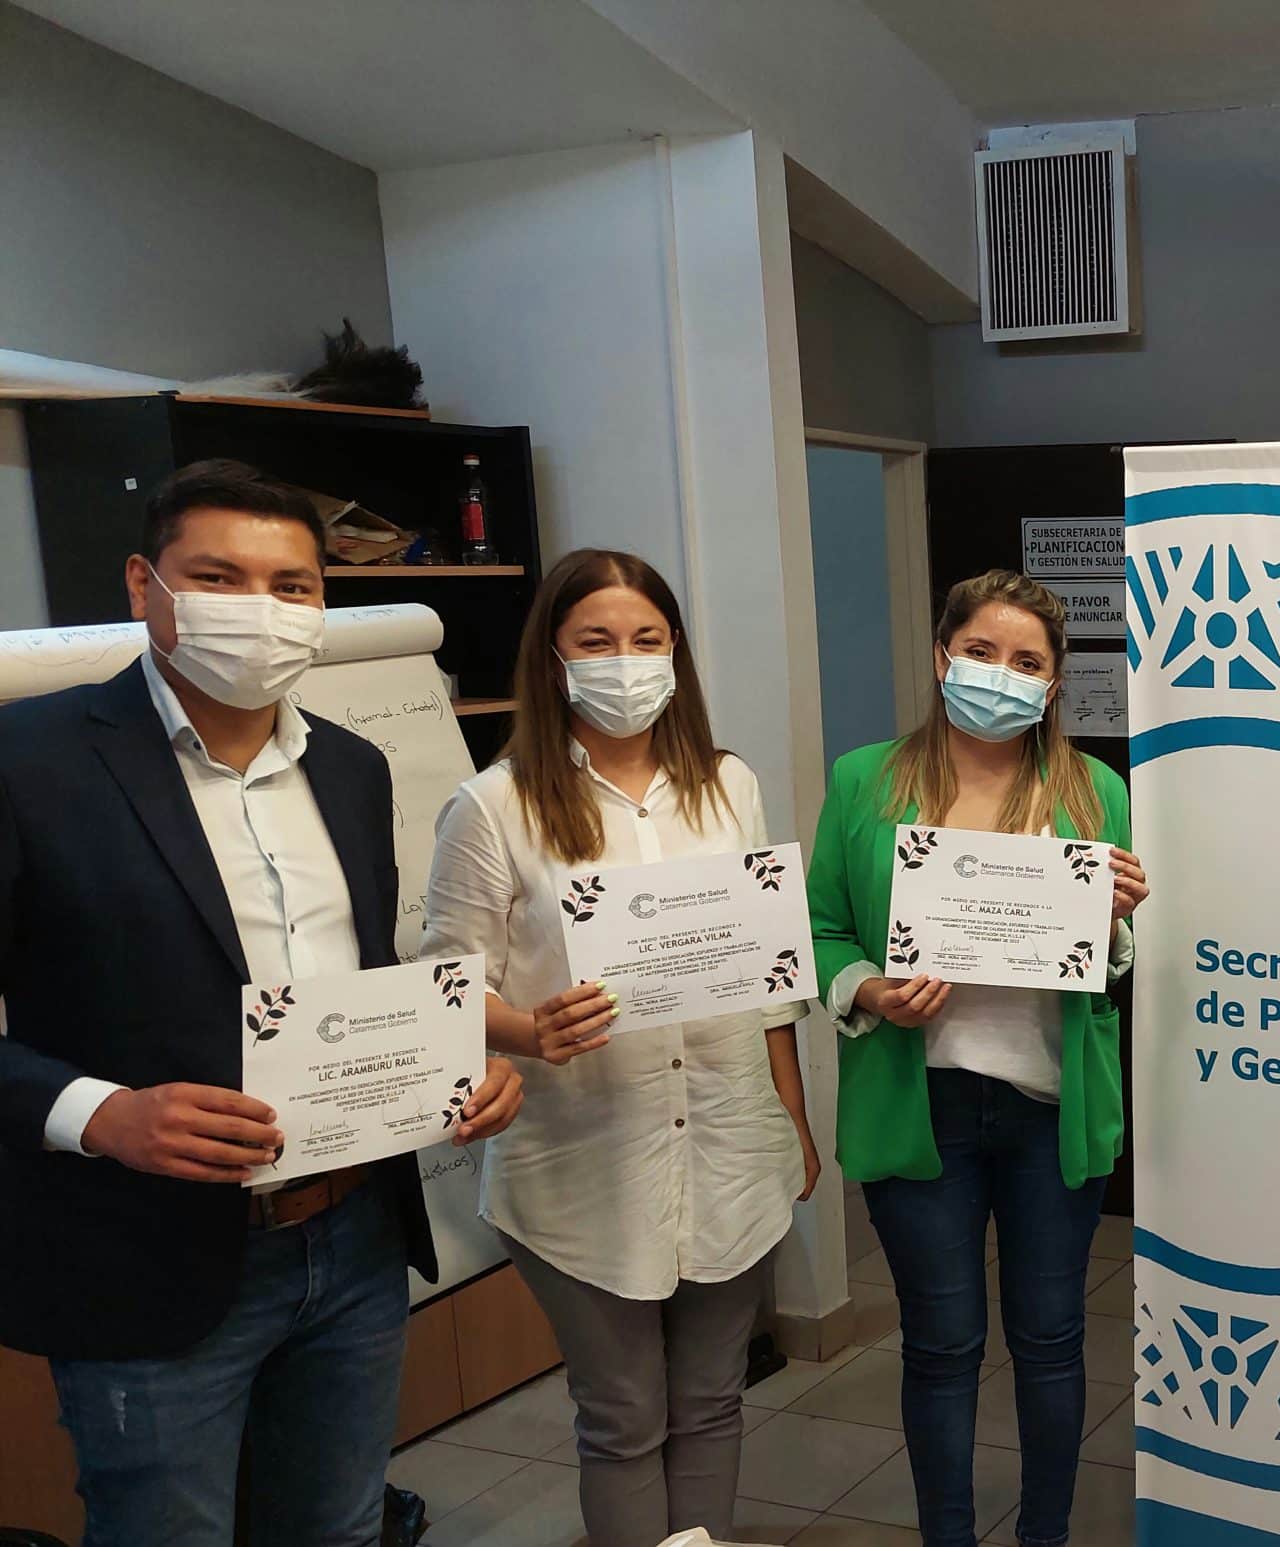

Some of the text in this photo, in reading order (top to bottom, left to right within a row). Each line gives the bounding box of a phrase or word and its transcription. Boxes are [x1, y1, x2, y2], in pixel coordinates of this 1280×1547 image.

[1031, 527, 1121, 538] SUBSECRETARIA DE
[1030, 540, 1124, 553] PLANIFICACION
[1029, 557, 1036, 567] Y
[1081, 556, 1093, 567] EN
[1095, 556, 1125, 567] SALUD
[1072, 596, 1111, 607] FAVOR
[1073, 611, 1123, 622] ANUNCIAR
[981, 862, 1014, 870] Ministerio
[659, 893, 695, 903] Ministerio
[707, 888, 727, 896] Salud
[960, 904, 1031, 916] LIC. MAZA CARLA
[638, 930, 732, 953] LIC. VERGARA VILMA
[1195, 991, 1245, 1028] de
[349, 1008, 416, 1026] Ministerio de Salud
[318, 1054, 418, 1081] LIC. ARAMBURU RAUL
[1195, 1047, 1218, 1082] y
